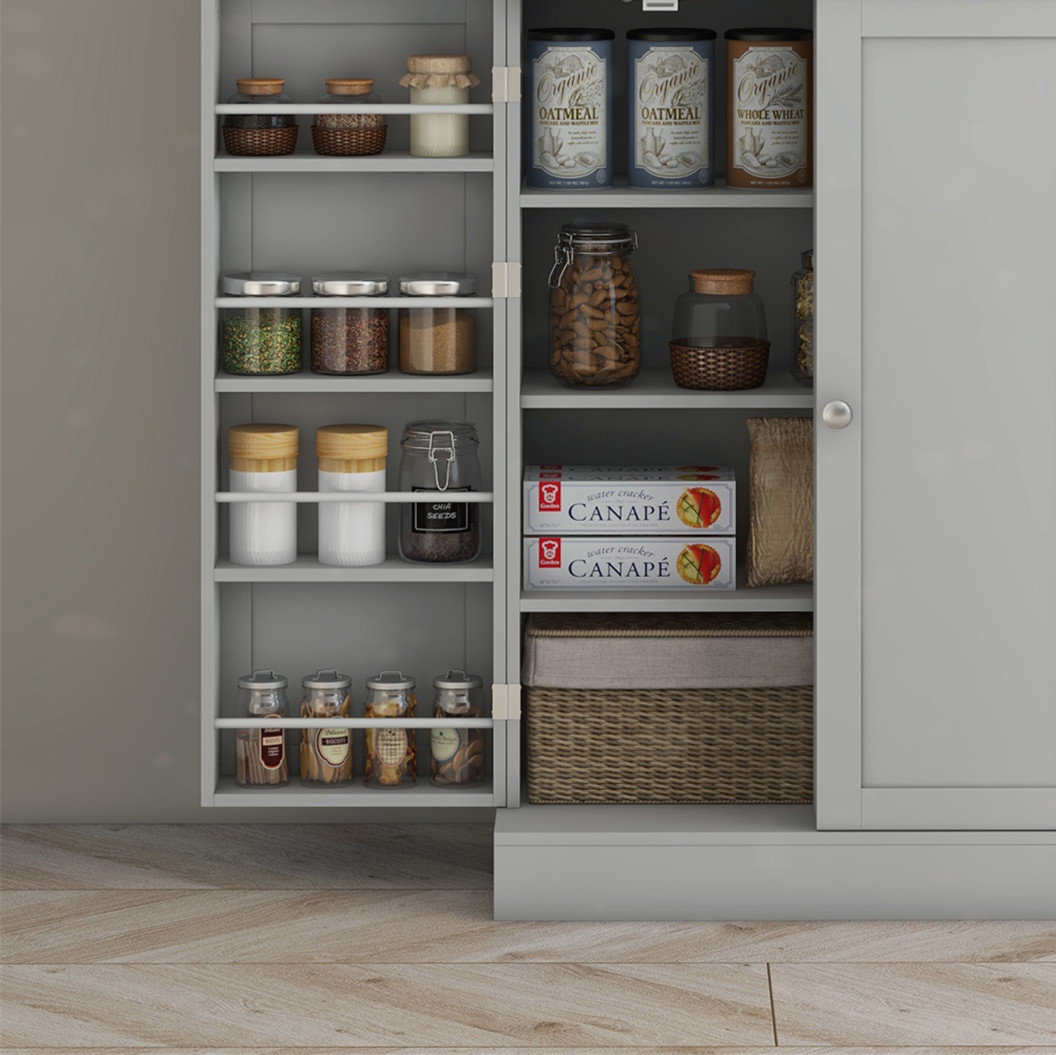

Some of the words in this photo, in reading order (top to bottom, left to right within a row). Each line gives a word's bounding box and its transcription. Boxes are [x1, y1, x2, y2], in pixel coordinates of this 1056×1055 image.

[537, 61, 597, 105] Organic
[639, 61, 699, 105] Organic
[737, 61, 799, 105] Organic
[538, 106, 599, 120] OATMEAL
[641, 106, 701, 120] OATMEAL
[736, 109, 771, 120] WHOLE
[772, 109, 804, 120] WHEAT
[587, 490, 615, 502] water
[617, 490, 655, 502] cracker
[426, 512, 457, 520] SEEDS
[568, 500, 671, 522] CANAPÉ
[587, 546, 615, 558] water
[617, 546, 655, 558] cracker
[568, 557, 671, 578] CANAPÉ
